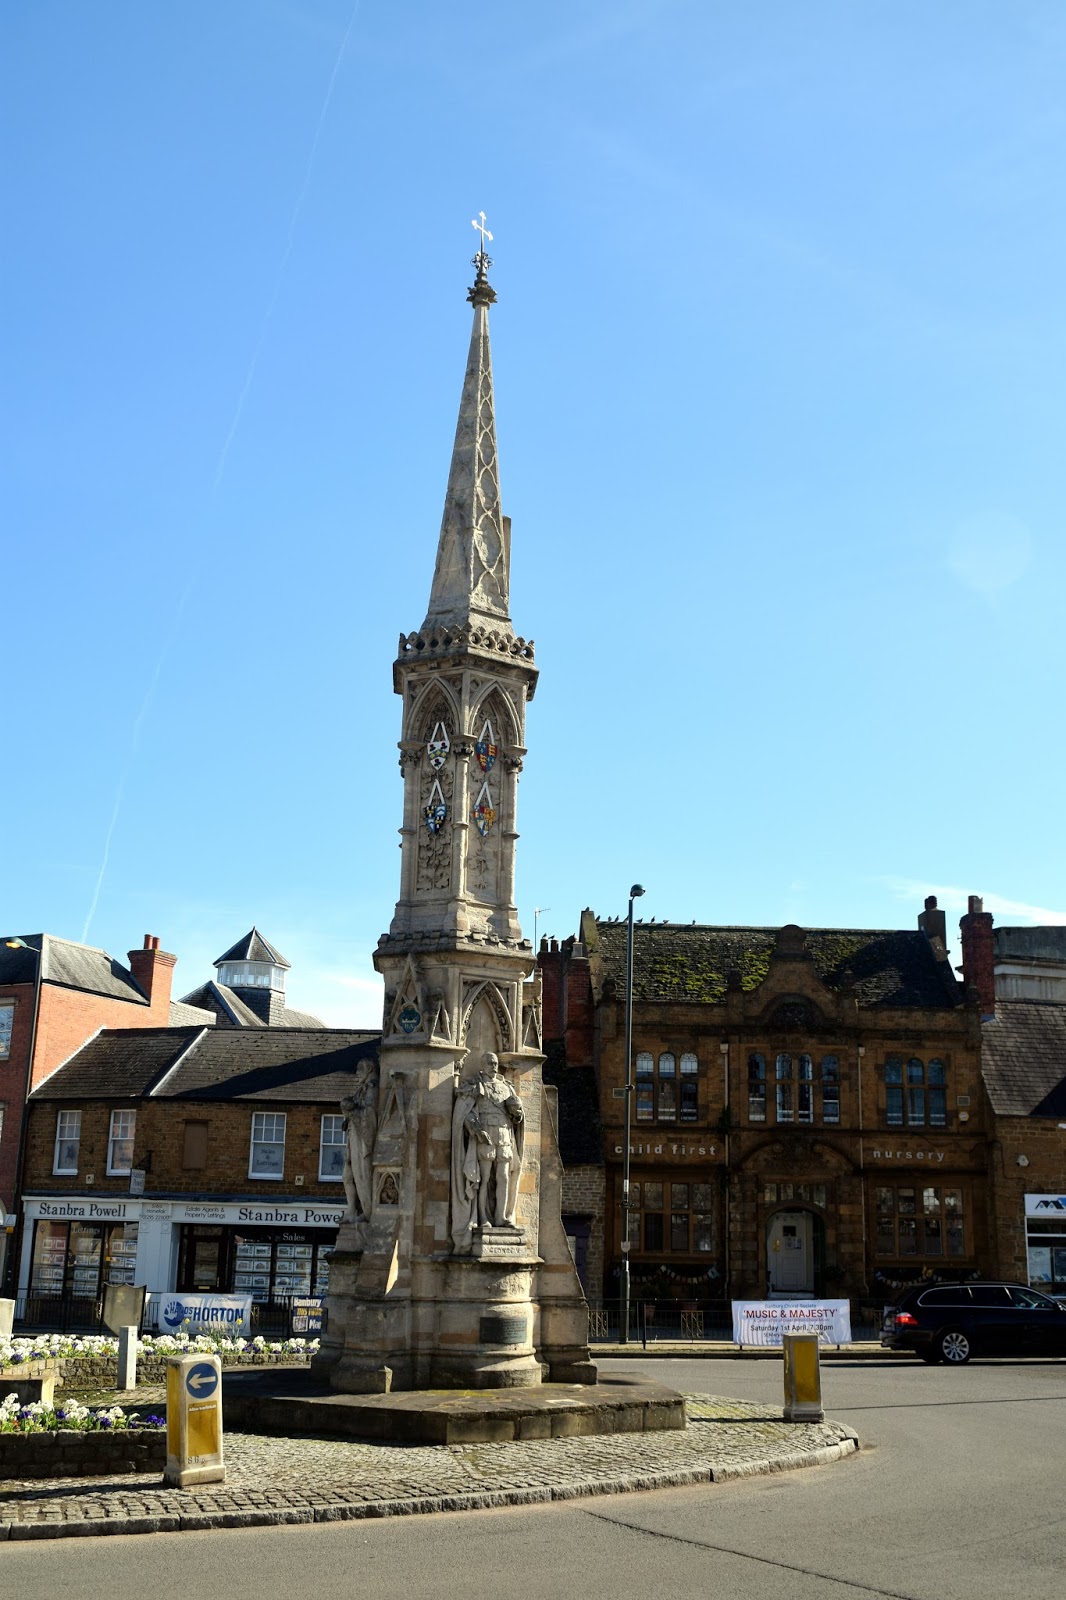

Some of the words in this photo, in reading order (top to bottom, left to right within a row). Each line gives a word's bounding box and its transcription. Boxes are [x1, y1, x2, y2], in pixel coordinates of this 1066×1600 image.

[672, 1144, 716, 1155] first
[873, 1150, 944, 1162] nursery
[39, 1202, 85, 1216] Stanbra
[89, 1203, 126, 1217] Powell
[238, 1208, 299, 1222] Stanbra
[73, 1225, 101, 1235] Lettings
[282, 1232, 306, 1241] Sales
[293, 1296, 322, 1308] Banbury
[193, 1306, 244, 1322] HORTON
[743, 1309, 778, 1319] 'MUSIC
[779, 1309, 787, 1318] &
[789, 1308, 838, 1318] MAJESTY'
[750, 1324, 778, 1332] Saturday
[791, 1324, 809, 1332] April,
[810, 1324, 834, 1332] 7.30pm
